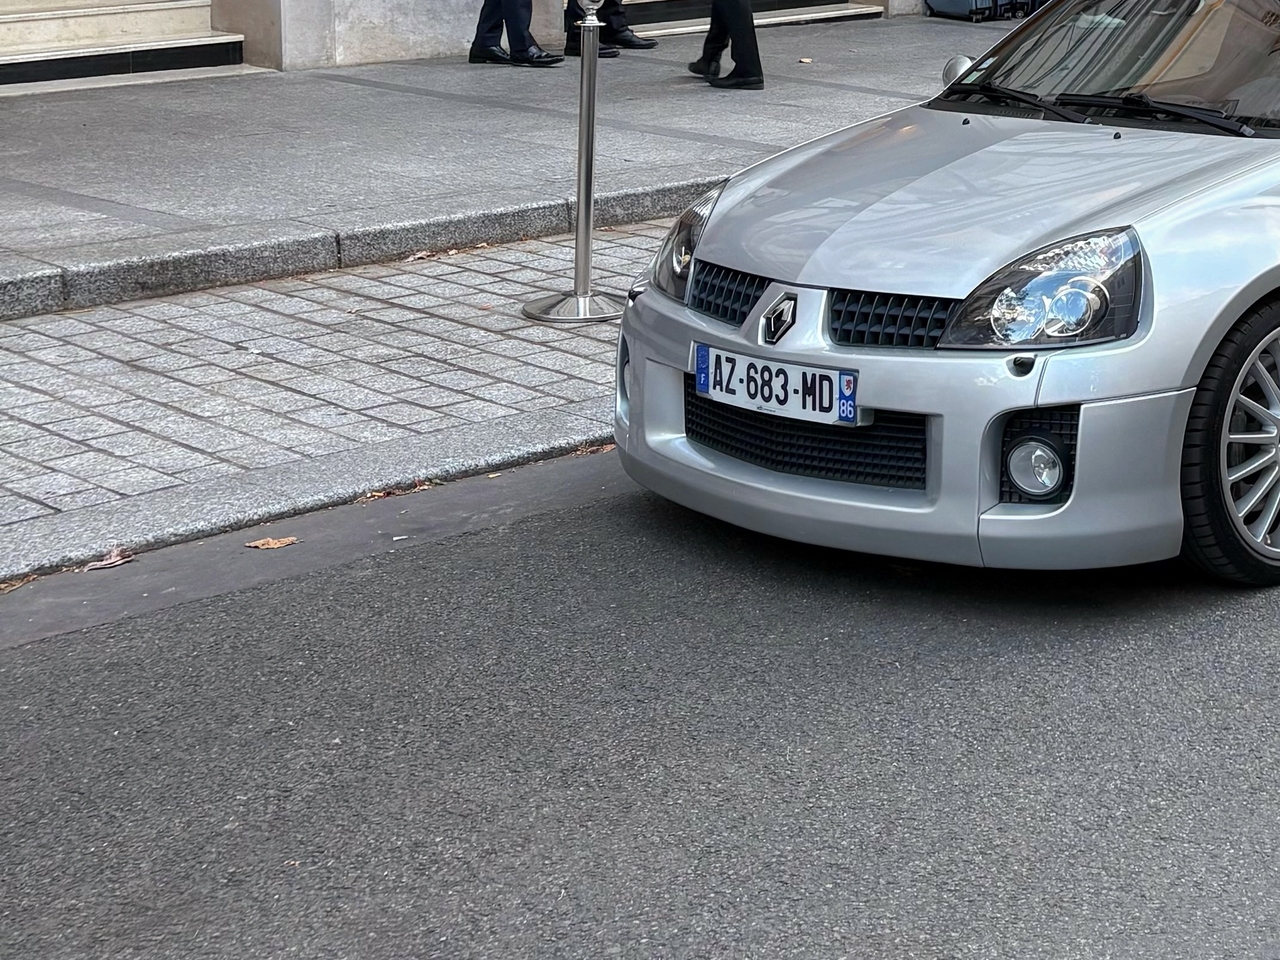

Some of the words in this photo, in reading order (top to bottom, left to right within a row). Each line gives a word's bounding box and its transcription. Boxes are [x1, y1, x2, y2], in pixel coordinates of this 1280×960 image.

[700, 373, 706, 384] F
[712, 353, 834, 413] AZ-683-MD
[839, 399, 855, 418] 86
